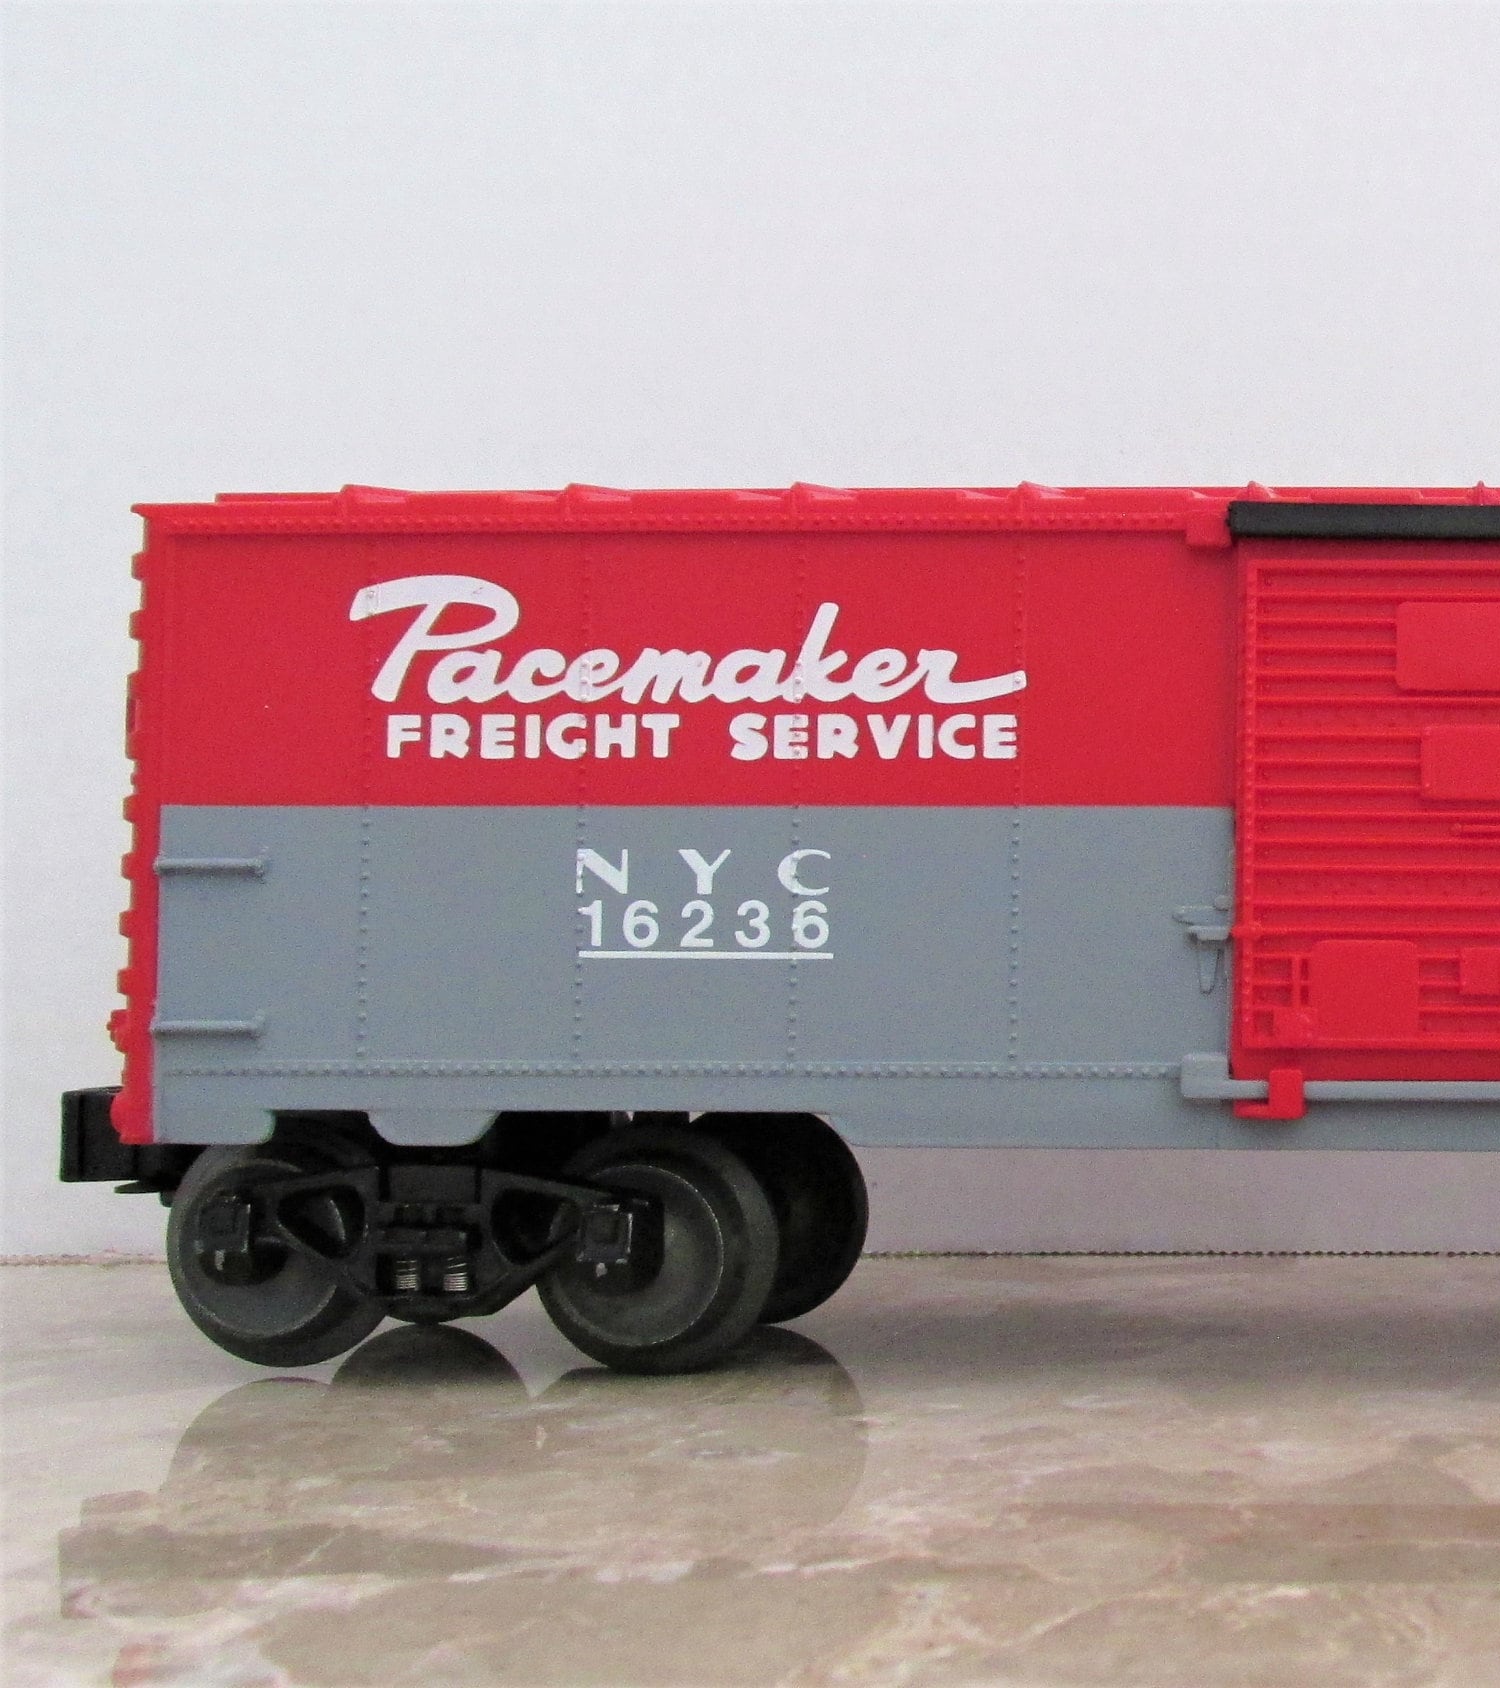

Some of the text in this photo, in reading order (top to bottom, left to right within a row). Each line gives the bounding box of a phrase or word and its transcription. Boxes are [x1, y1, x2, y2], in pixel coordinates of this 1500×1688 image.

[349, 574, 1027, 705] Pacemaker
[386, 712, 1018, 761] FREIGHT SERVICE
[577, 899, 831, 949] 16236
